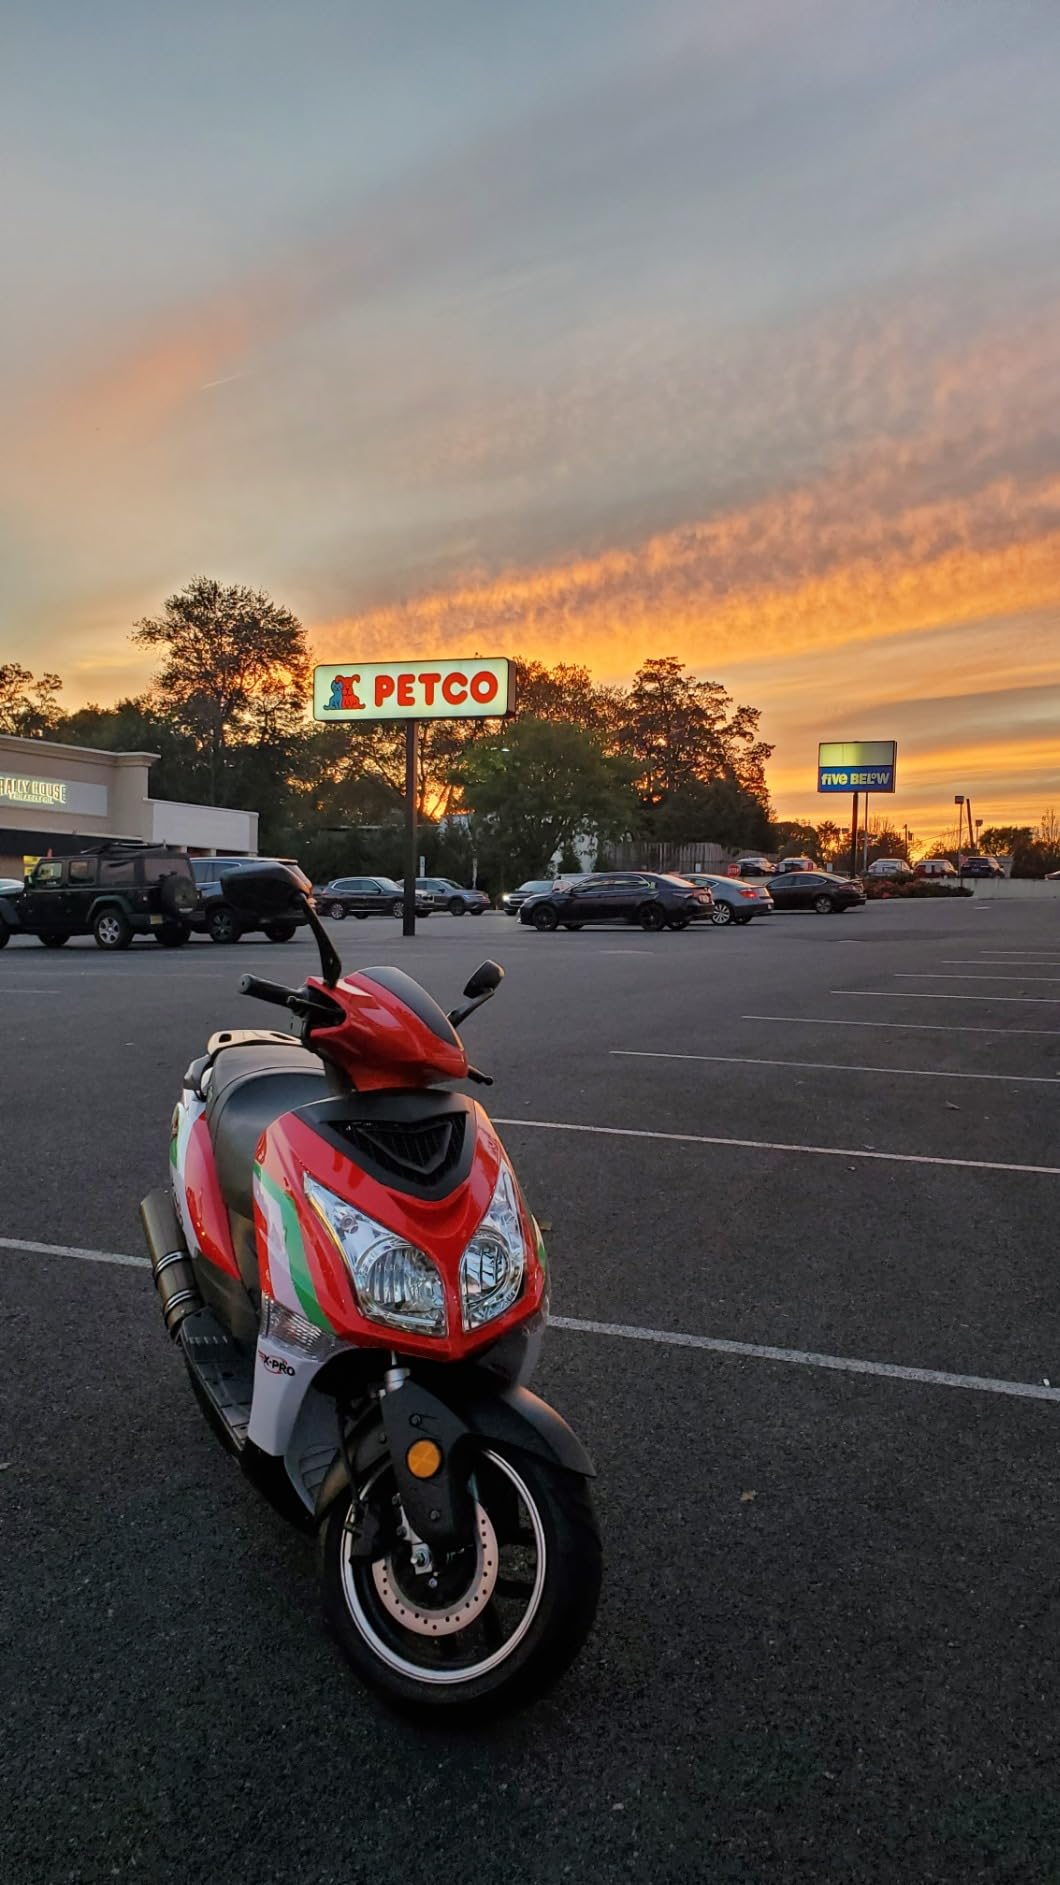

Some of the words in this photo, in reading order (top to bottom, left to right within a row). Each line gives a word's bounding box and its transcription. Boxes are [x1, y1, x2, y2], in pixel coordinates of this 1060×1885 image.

[374, 671, 499, 708] PETCO
[821, 773, 848, 785] five
[32, 780, 67, 803] HOUSE
